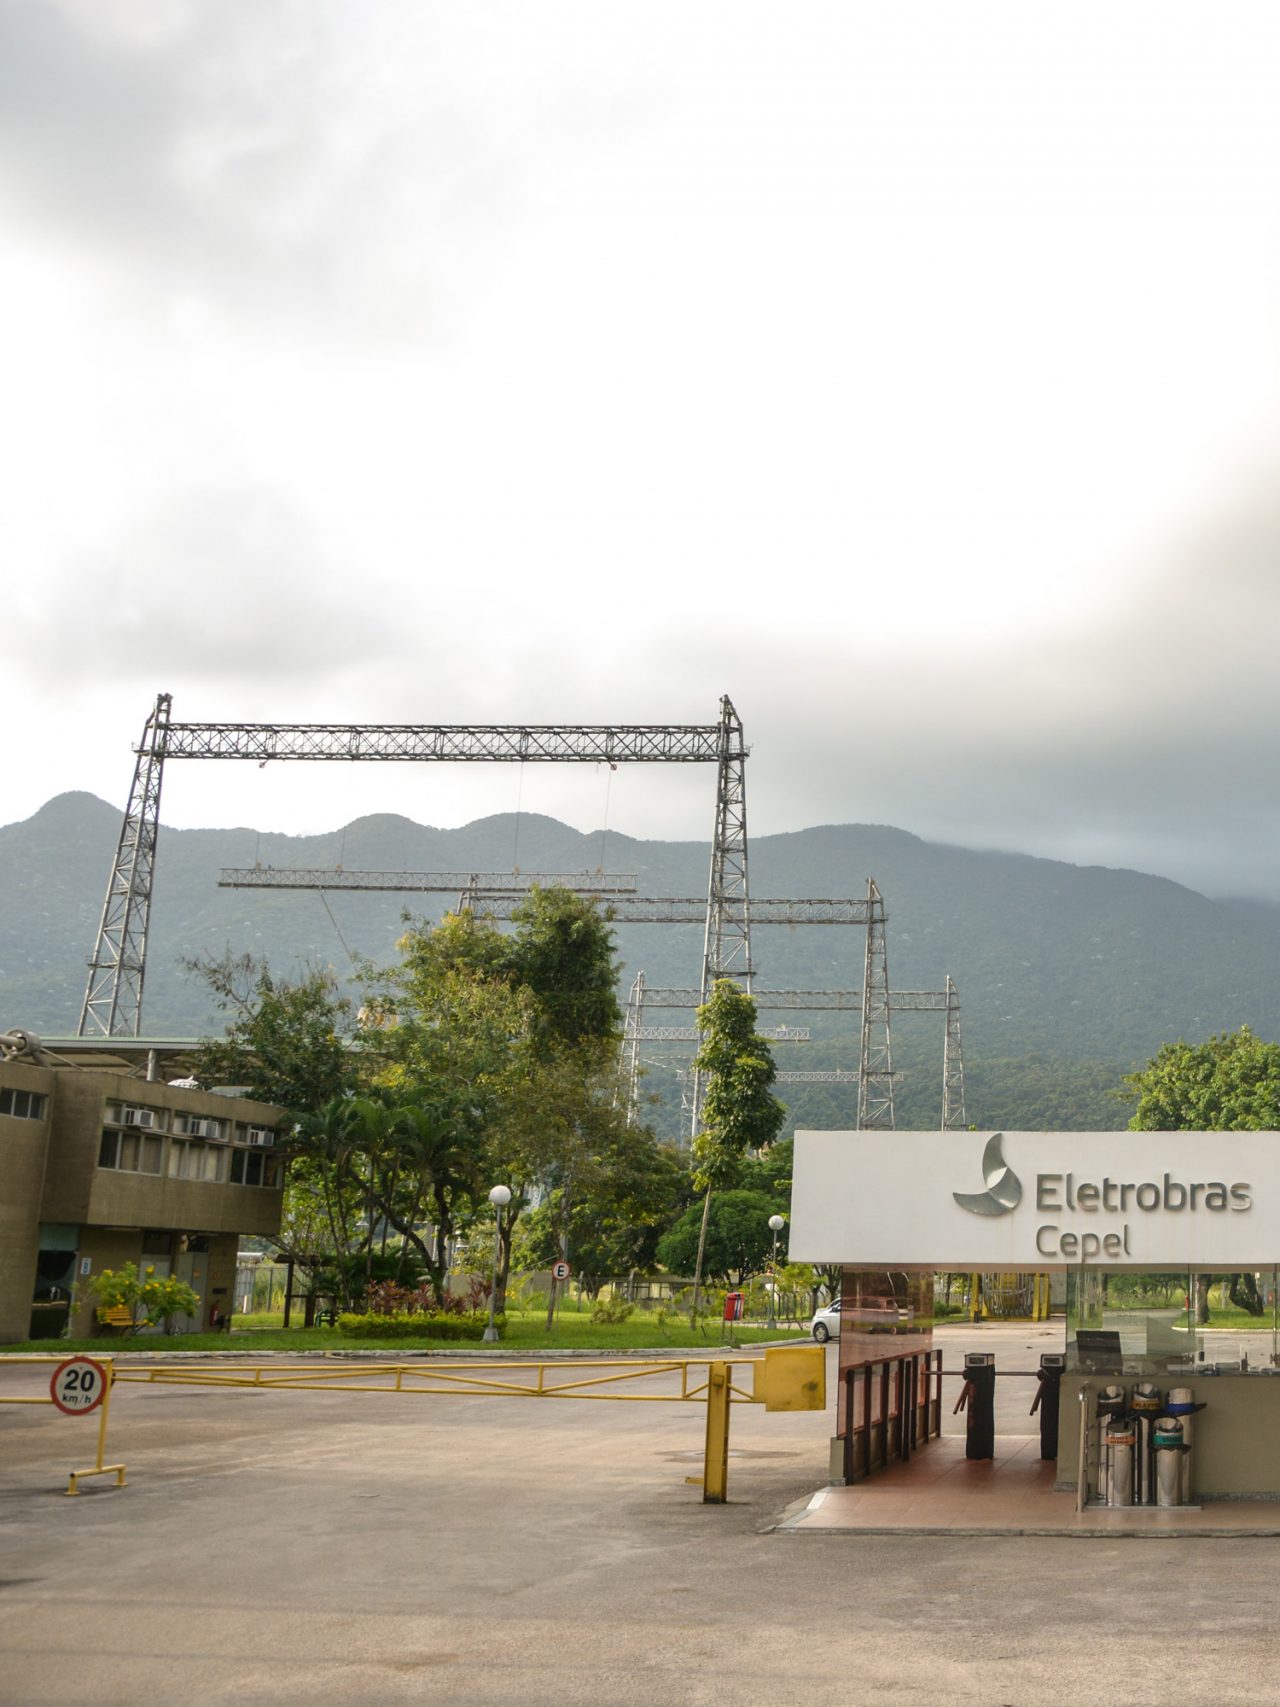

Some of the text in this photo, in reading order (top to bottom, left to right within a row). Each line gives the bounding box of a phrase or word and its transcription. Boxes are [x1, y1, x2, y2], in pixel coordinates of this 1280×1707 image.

[1036, 1172, 1253, 1213] Eletrobras
[1036, 1224, 1131, 1263] Cepel
[557, 1265, 565, 1277] E
[64, 1369, 95, 1392] 20
[62, 1393, 92, 1404] km/h
